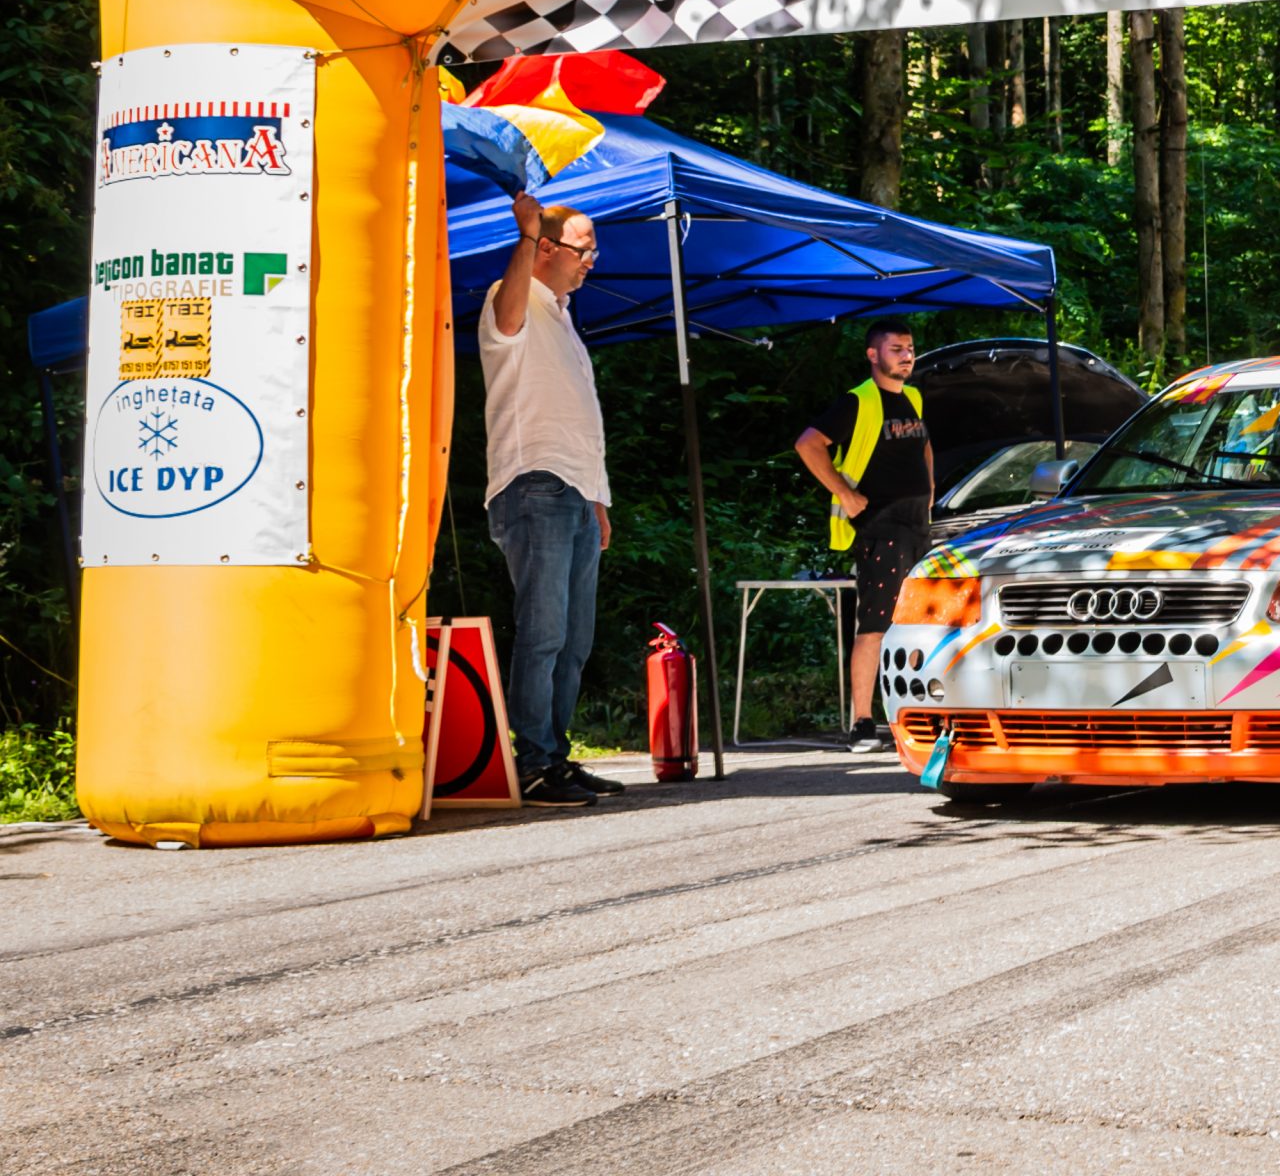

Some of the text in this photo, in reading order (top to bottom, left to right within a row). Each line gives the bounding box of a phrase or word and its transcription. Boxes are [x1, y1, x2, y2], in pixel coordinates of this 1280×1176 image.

[151, 248, 234, 276] banat
[111, 279, 234, 301] TIPOGRAFIE
[109, 466, 224, 493] ICE DYP
